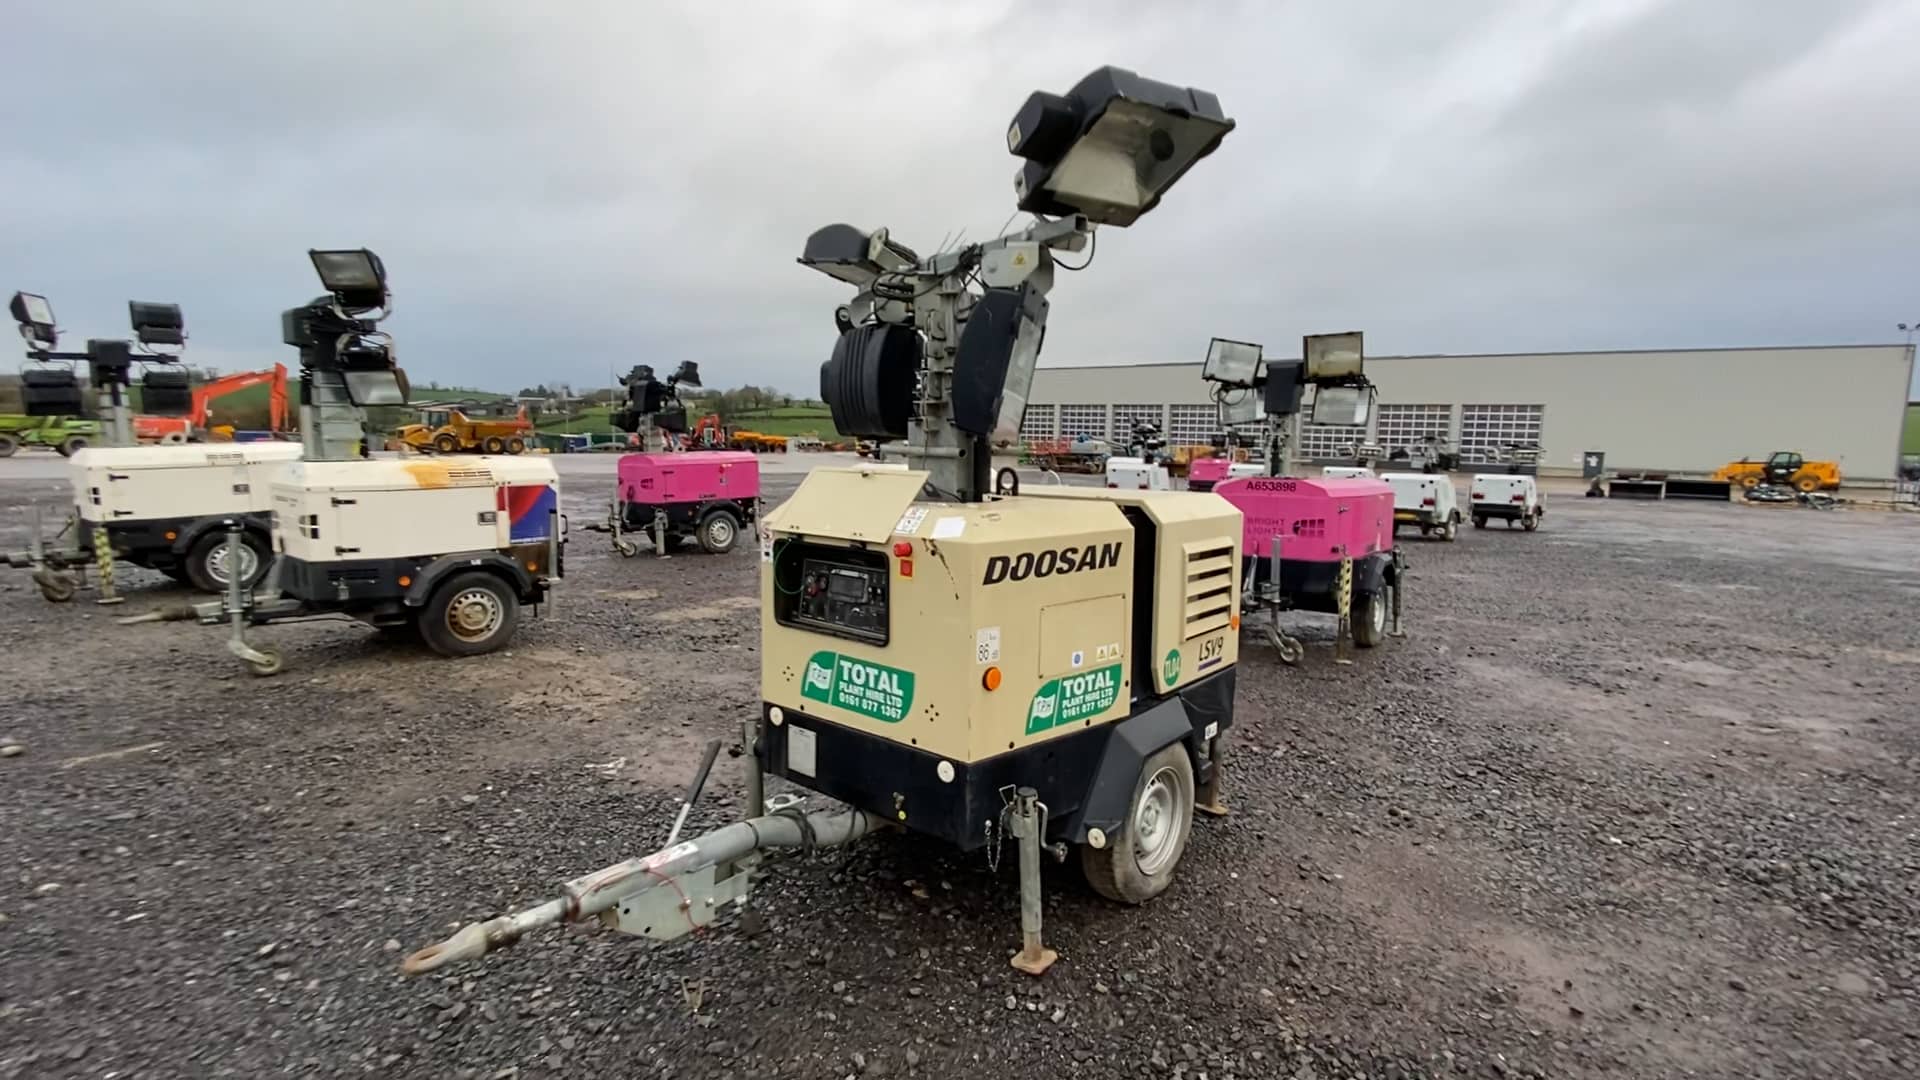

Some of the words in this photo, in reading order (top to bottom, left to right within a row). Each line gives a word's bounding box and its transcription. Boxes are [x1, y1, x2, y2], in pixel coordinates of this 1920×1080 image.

[1247, 481, 1297, 492] A653898
[982, 541, 1122, 586] DOOSAN
[1199, 636, 1224, 661] LSV9
[839, 659, 904, 697] TOTAL
[1063, 670, 1114, 698] TOTAL
[838, 691, 860, 707] 0161
[839, 681, 864, 697] PLANT
[865, 688, 885, 704] HIRE
[886, 693, 903, 708] LTD
[1062, 695, 1084, 709] PLANT
[1085, 690, 1100, 702] HIRE
[1101, 687, 1113, 698] LTD
[1062, 706, 1080, 719] 0161
